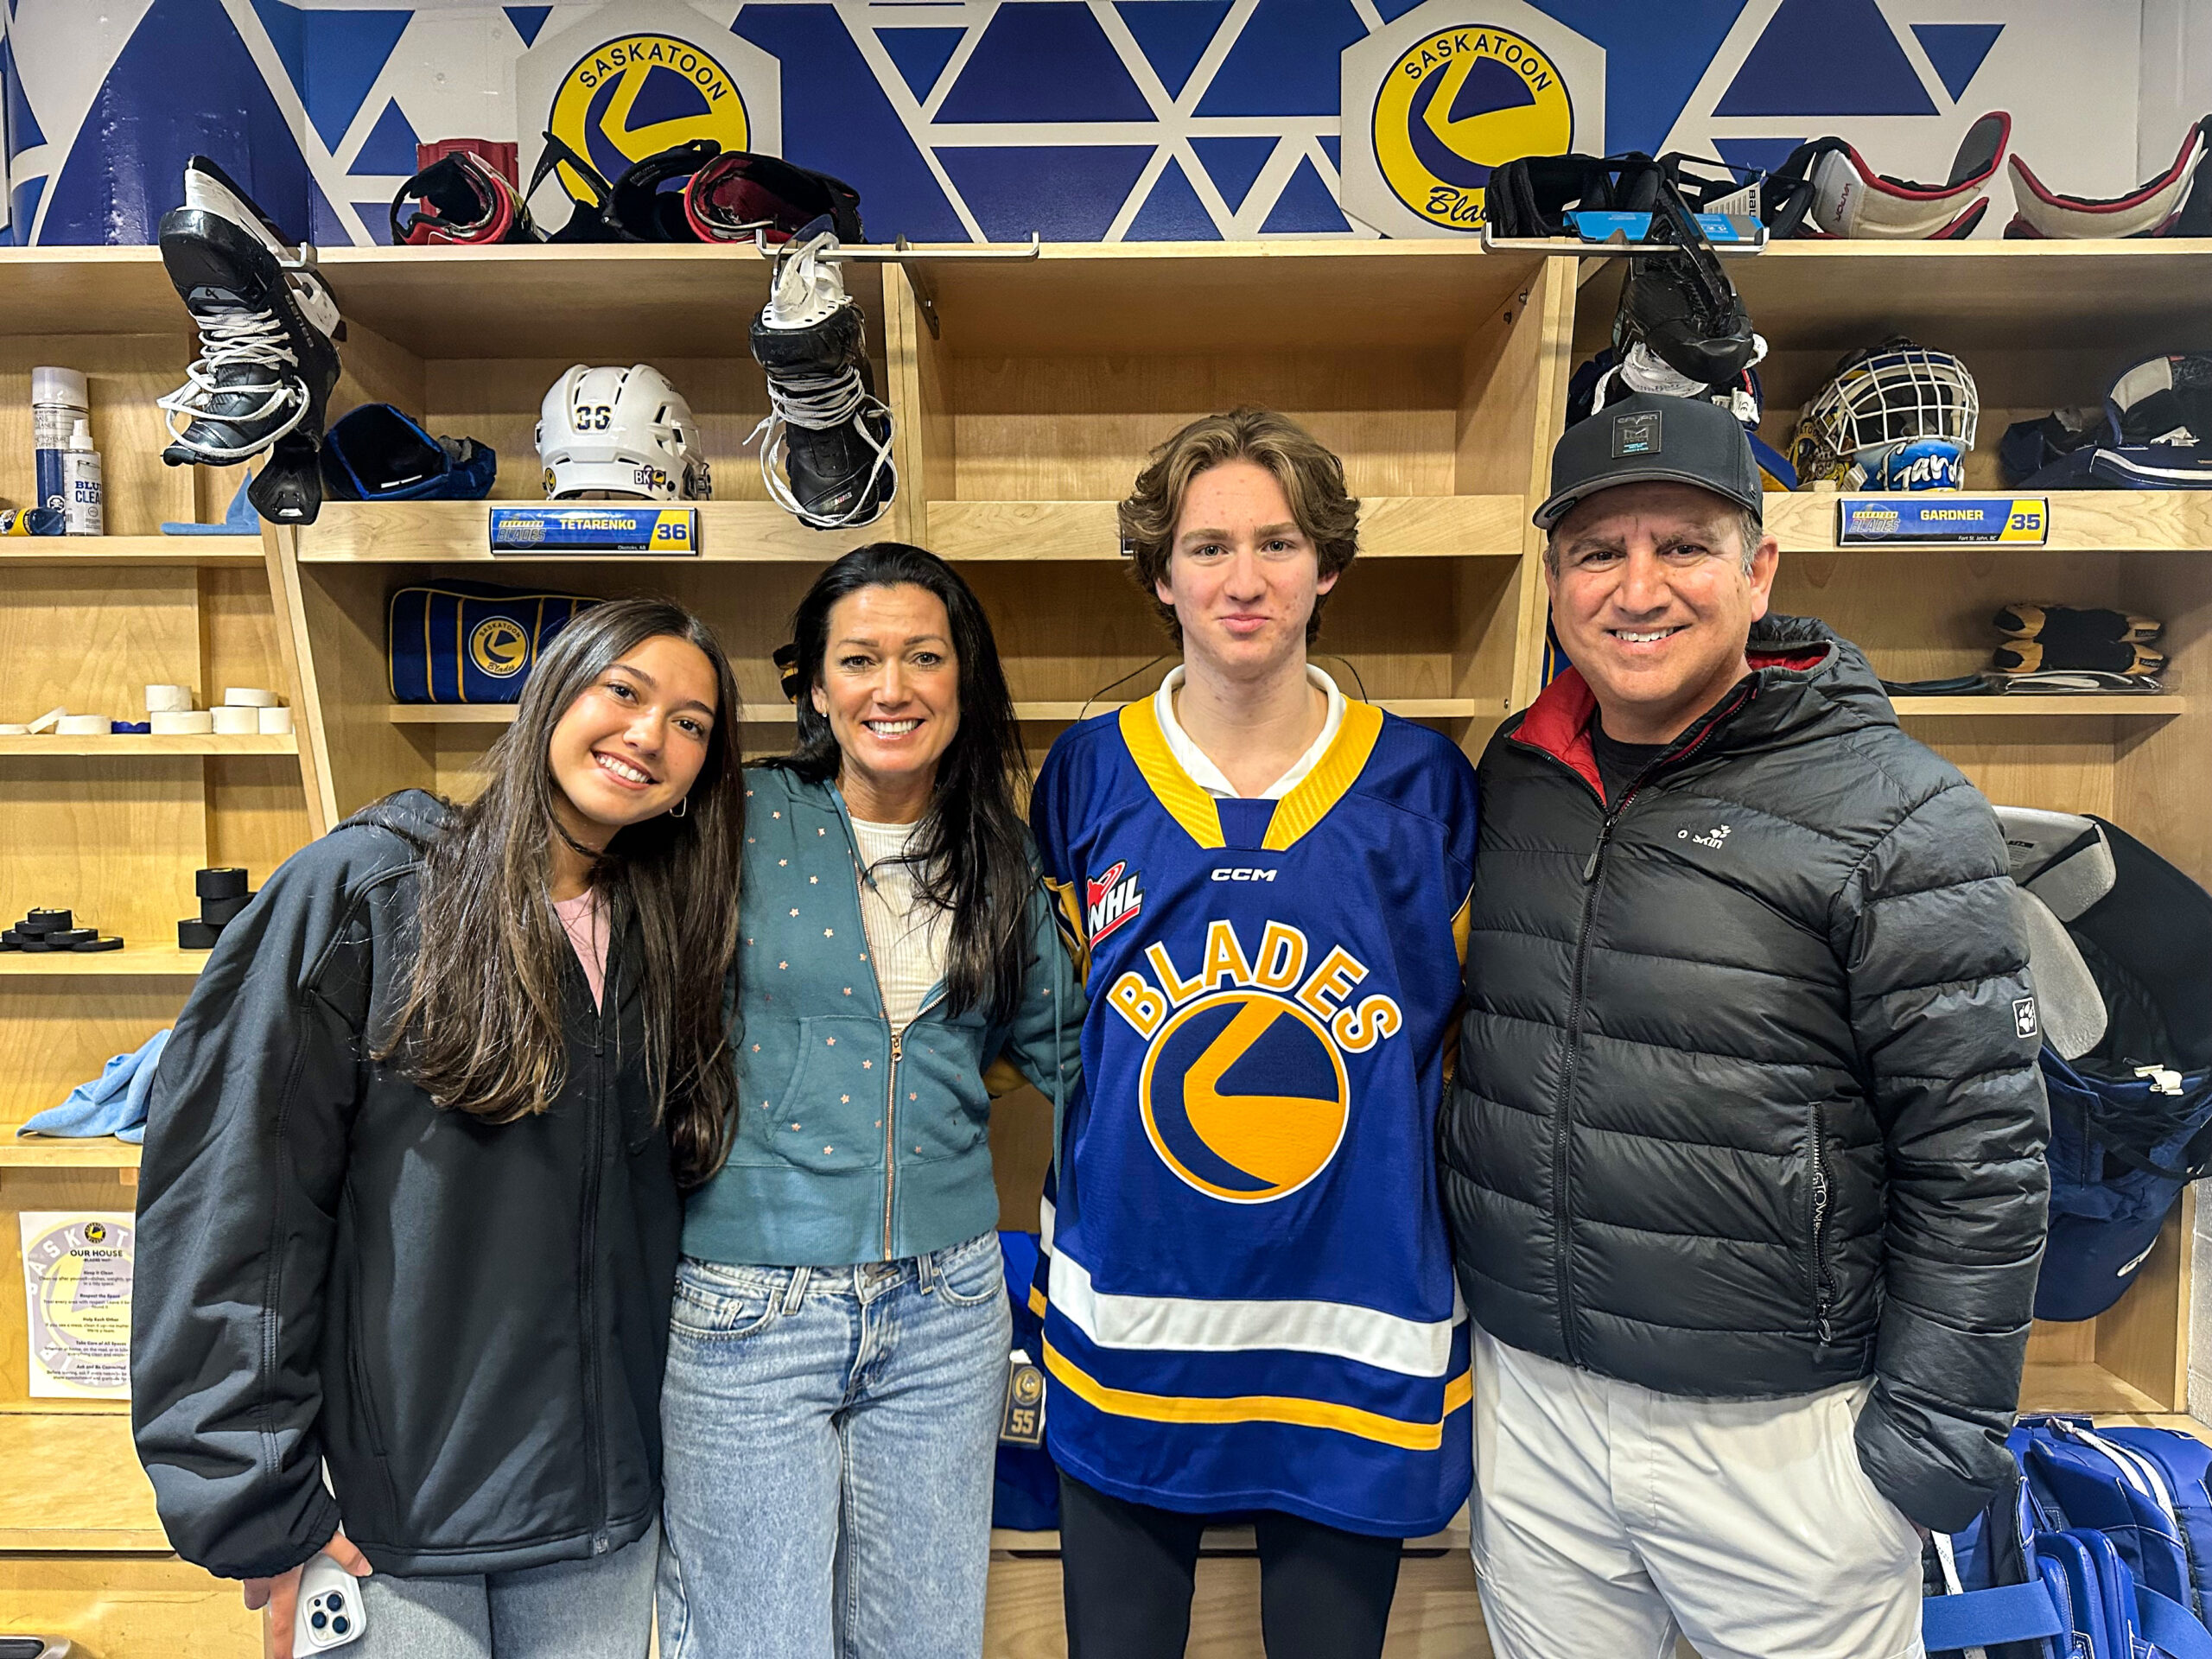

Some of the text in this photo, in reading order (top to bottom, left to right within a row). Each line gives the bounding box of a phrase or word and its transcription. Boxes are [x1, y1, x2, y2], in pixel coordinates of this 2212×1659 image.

[1404, 33, 1552, 92] SASKATOON
[579, 42, 728, 101] SASKATOON
[1426, 186, 1487, 222] Bla
[576, 406, 611, 429] 36
[75, 490, 102, 505] CLEA
[1920, 510, 1984, 520] GARDNER
[2011, 513, 2041, 530] 35
[559, 519, 636, 530] TETARENKO
[657, 524, 687, 540] 36
[1849, 518, 1901, 532] BLADES
[497, 527, 546, 542] BLADES
[479, 622, 521, 639] SASKATOON
[487, 662, 515, 671] Blades
[1211, 868, 1277, 882] CCM
[1088, 874, 1143, 940] WHL
[1106, 919, 1403, 1053] BLADES
[1011, 1408, 1035, 1434] 55
